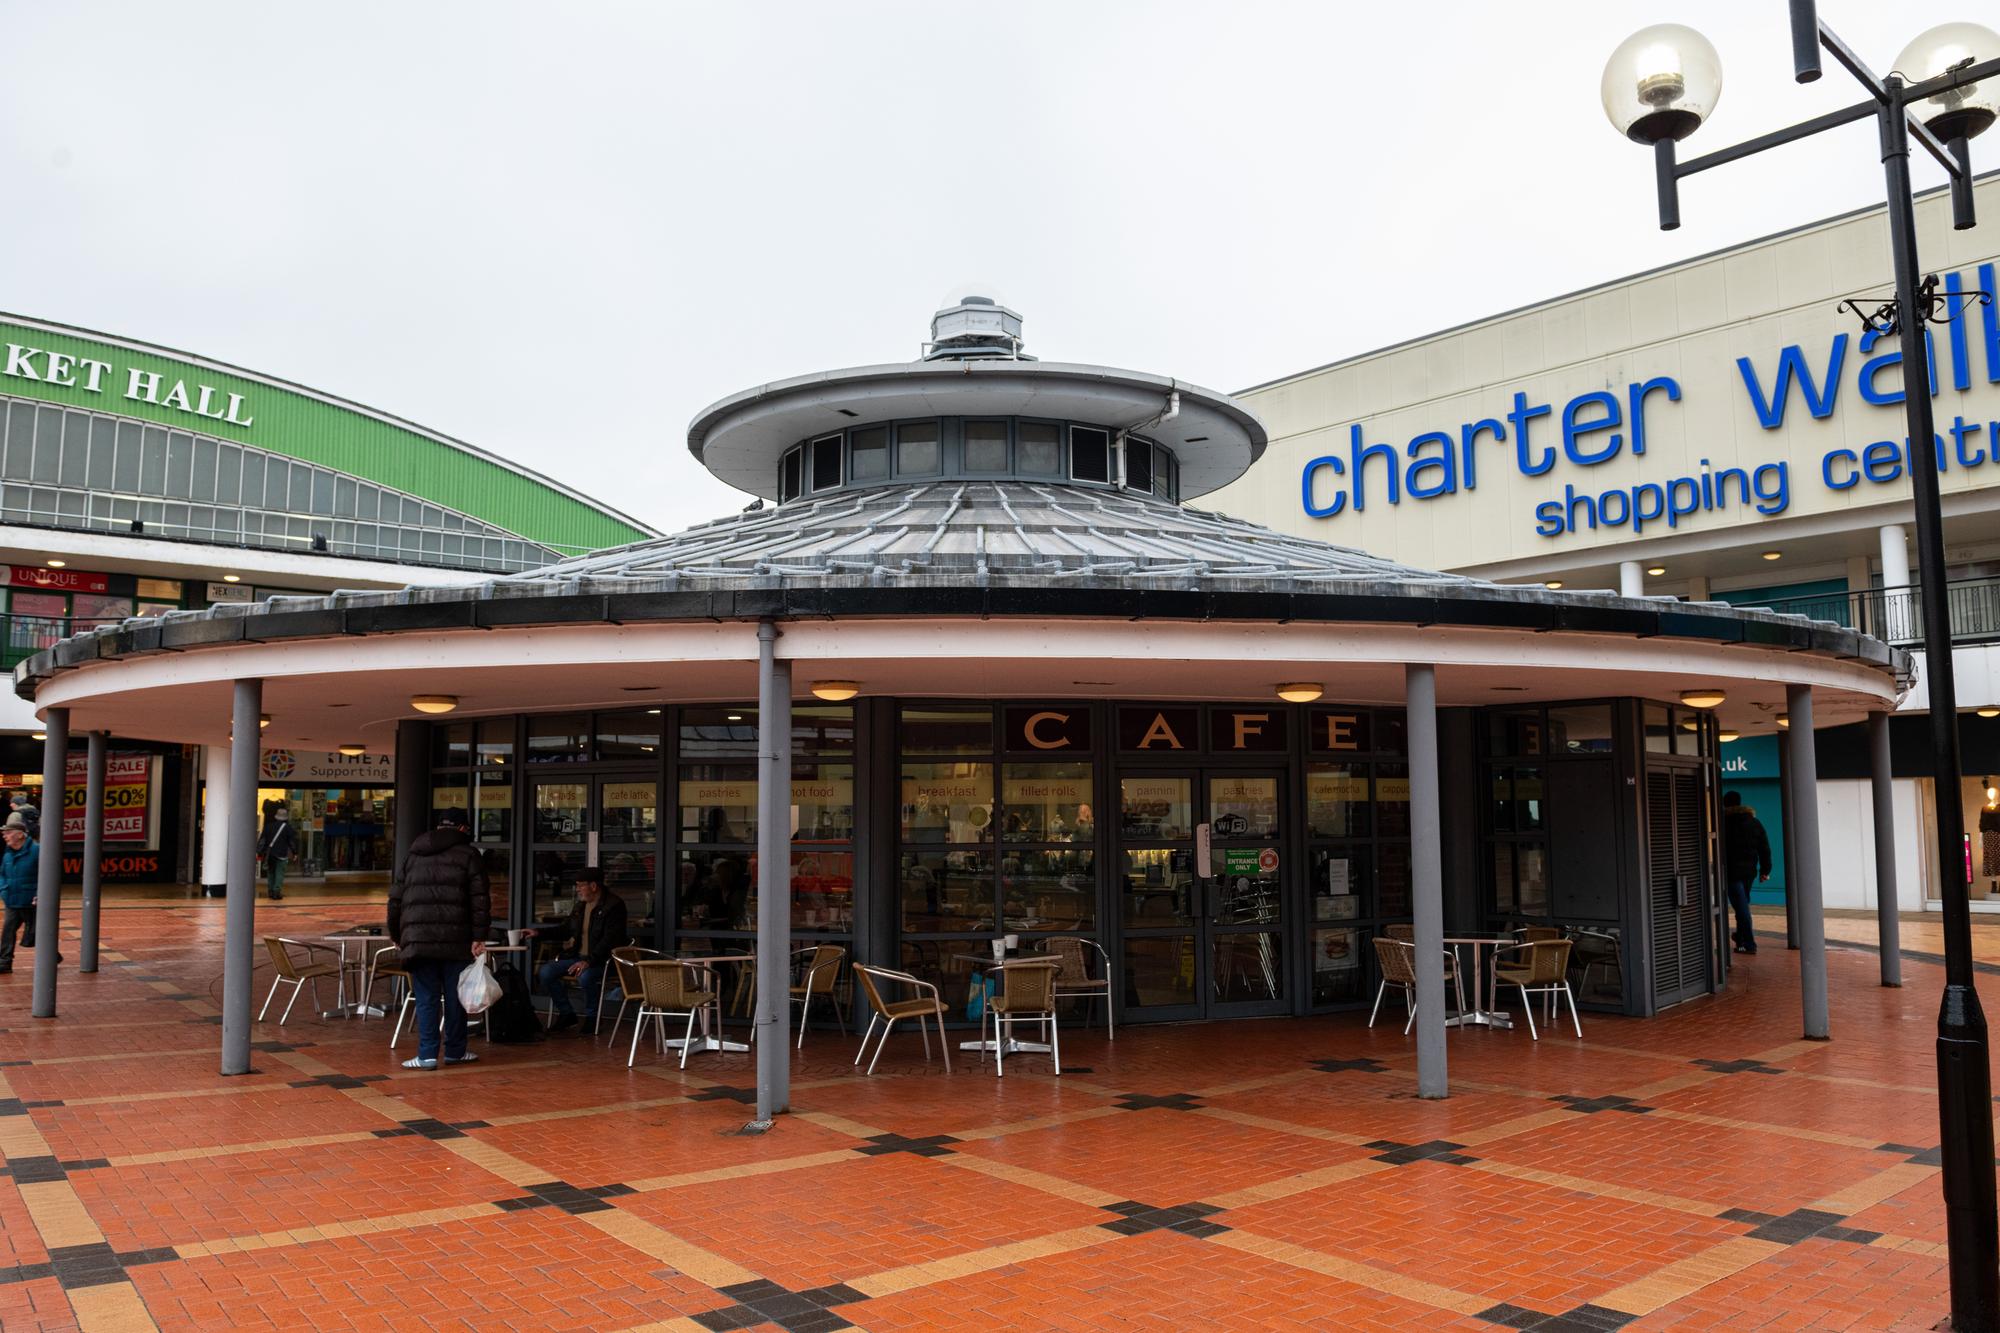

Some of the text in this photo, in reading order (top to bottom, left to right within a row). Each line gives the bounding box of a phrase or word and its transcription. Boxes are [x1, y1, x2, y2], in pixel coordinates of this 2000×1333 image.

[123, 368, 253, 427] HALL
[1301, 376, 1681, 519] charter
[1536, 458, 1790, 536] shopping
[18, 569, 78, 587] UNIQUE
[65, 760, 88, 773] SAL
[108, 760, 144, 773] SALE
[310, 765, 389, 779] Supporting
[699, 787, 741, 799] pastries
[809, 786, 835, 798] food
[918, 786, 977, 797] breakfast
[1020, 786, 1076, 797] filled rolls
[1223, 785, 1263, 797] pastries
[64, 821, 85, 833] SAL
[106, 819, 141, 832] SALE
[63, 857, 158, 874] WNSORS
